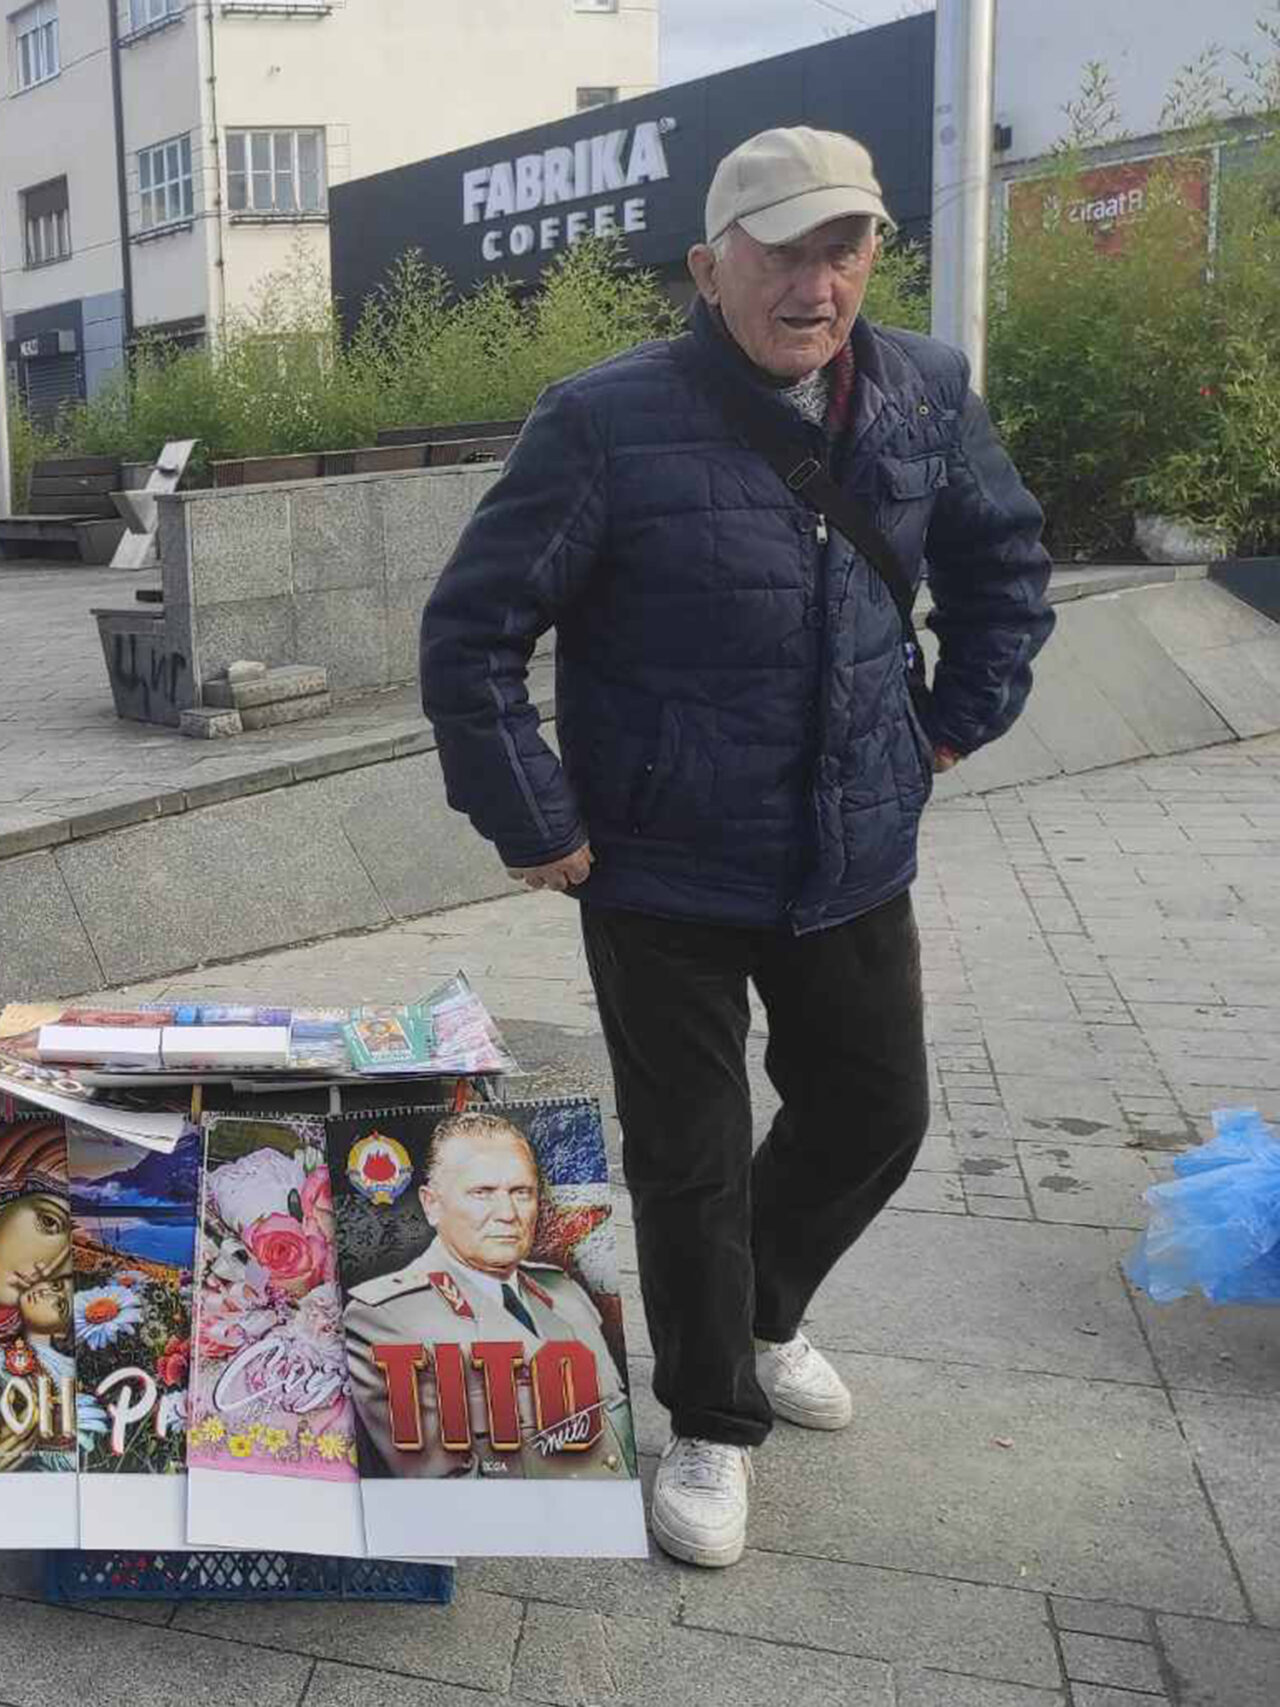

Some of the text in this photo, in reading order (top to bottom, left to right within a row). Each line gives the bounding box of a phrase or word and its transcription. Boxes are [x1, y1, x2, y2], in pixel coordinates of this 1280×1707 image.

[463, 121, 670, 225] FABRIKA
[481, 198, 647, 261] COFFEE
[372, 1340, 604, 1452] TITO
